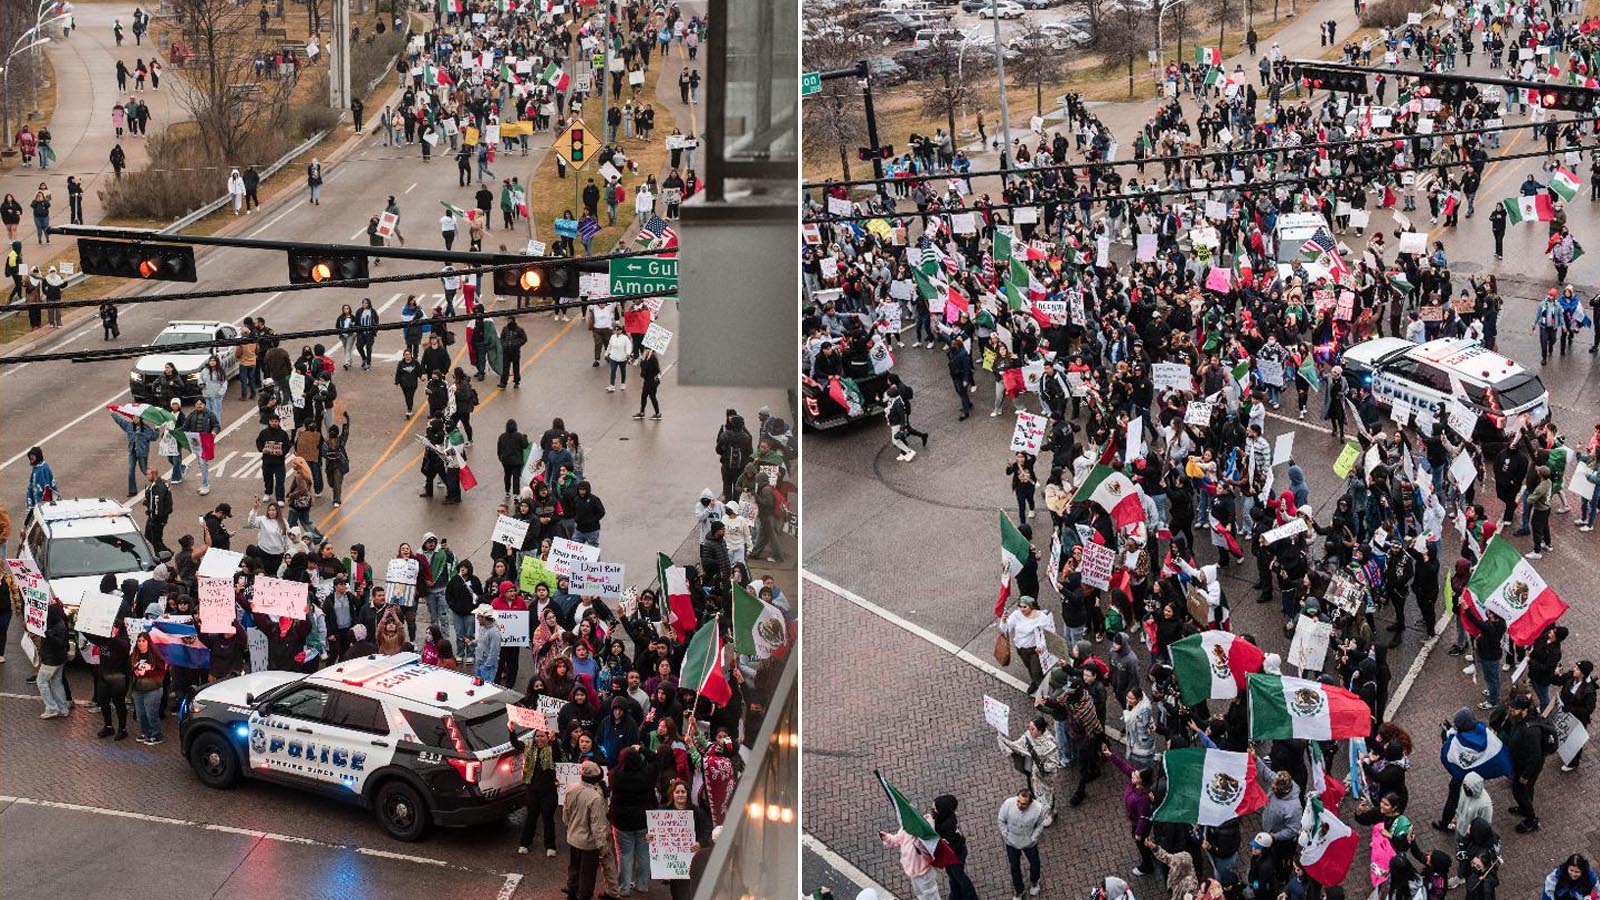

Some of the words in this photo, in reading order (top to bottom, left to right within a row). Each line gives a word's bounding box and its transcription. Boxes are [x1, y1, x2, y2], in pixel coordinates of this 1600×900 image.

[578, 82, 589, 90] 35
[648, 261, 679, 276] Gul
[613, 280, 678, 294] Amon
[269, 734, 367, 772] POLICE
